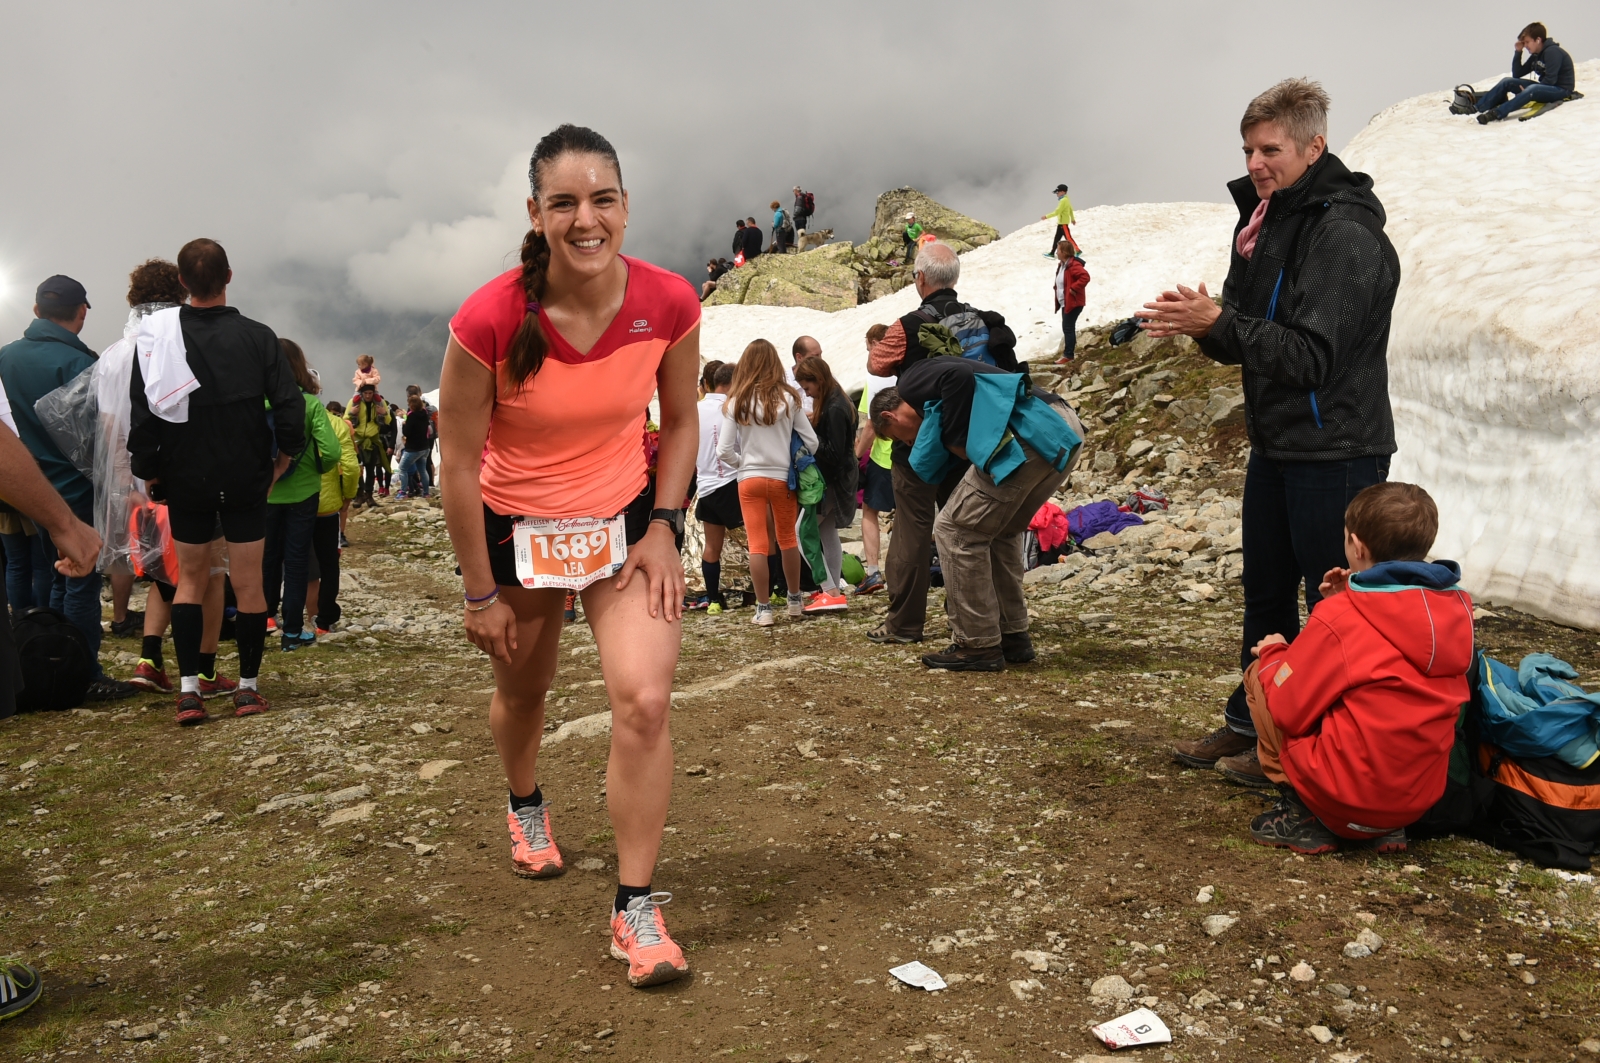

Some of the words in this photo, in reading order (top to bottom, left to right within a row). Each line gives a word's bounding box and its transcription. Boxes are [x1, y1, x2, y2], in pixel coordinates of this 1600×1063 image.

[517, 519, 550, 527] RAIFFEISEN
[535, 530, 608, 561] 1689
[563, 561, 586, 576] LEA
